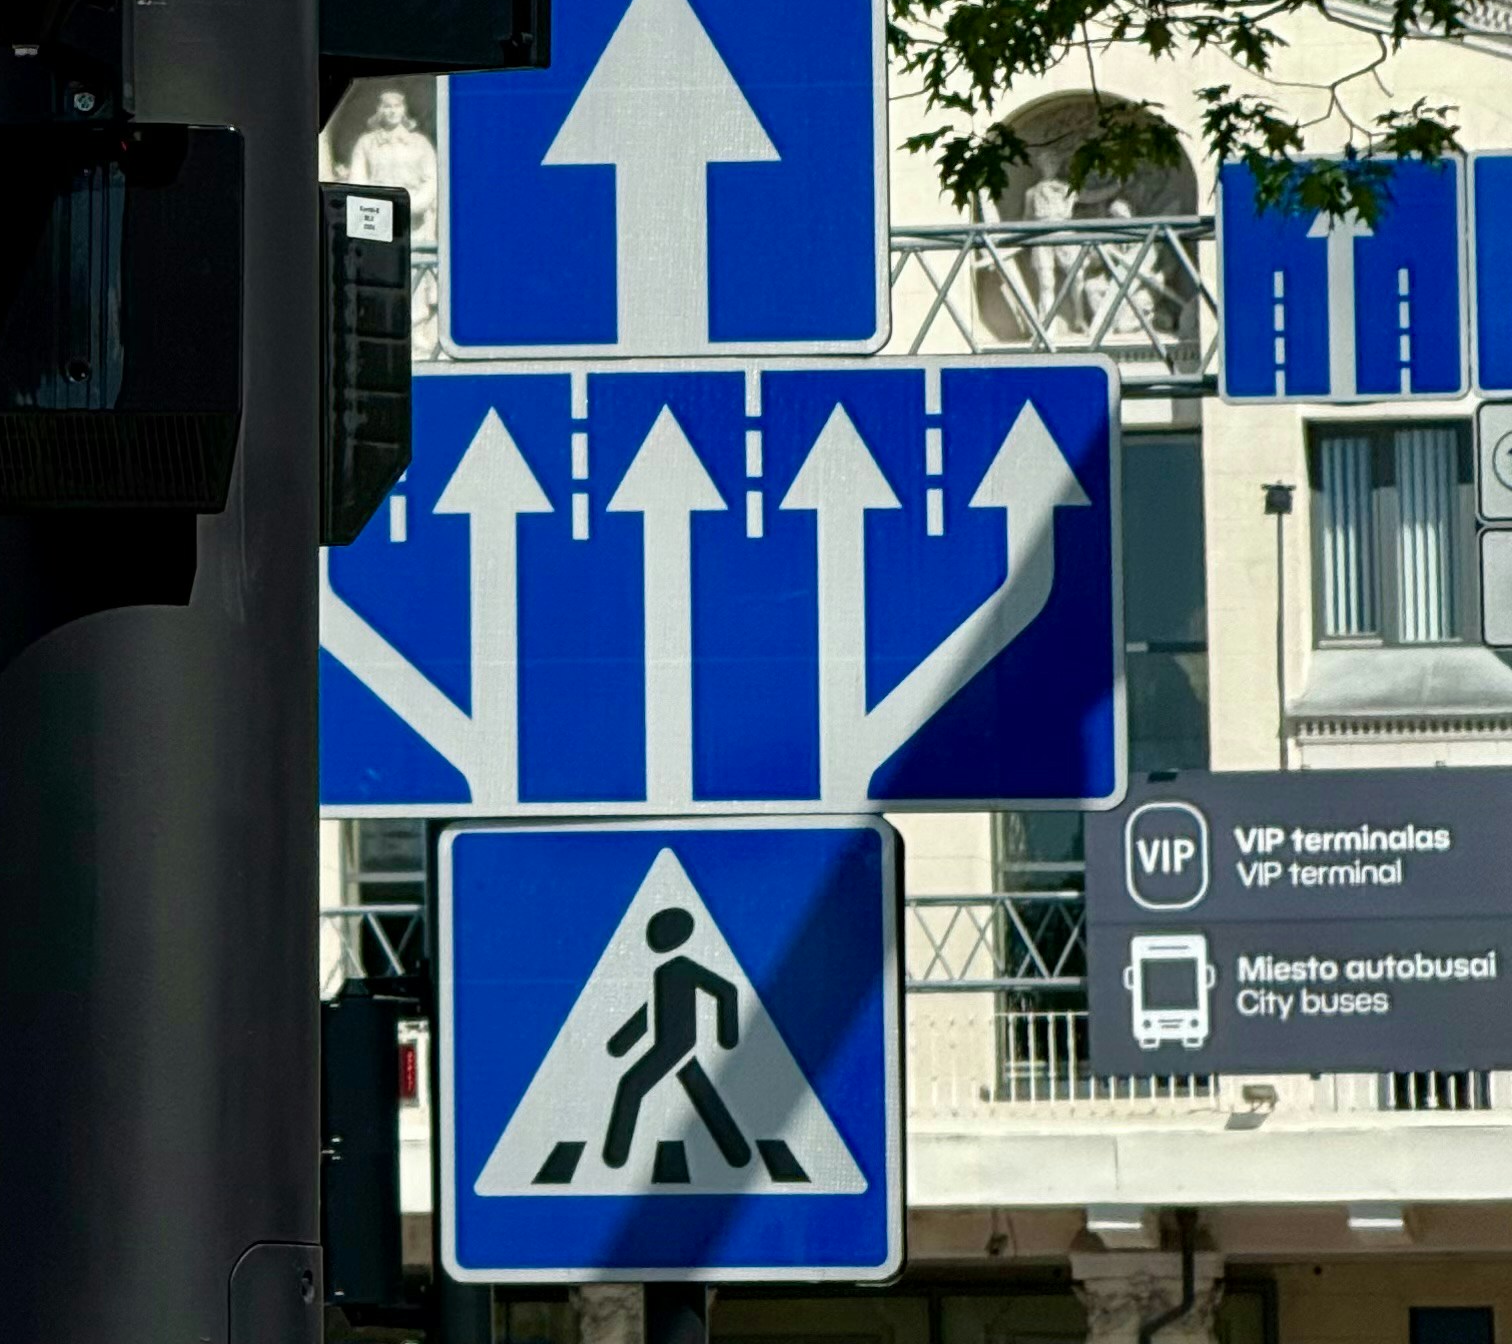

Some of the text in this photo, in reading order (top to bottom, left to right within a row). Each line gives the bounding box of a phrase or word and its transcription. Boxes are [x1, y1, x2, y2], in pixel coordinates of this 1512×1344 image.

[1234, 823, 1451, 854] VIP terminalas
[1136, 838, 1196, 874] VIP
[1236, 857, 1403, 888] VIP terminal
[1238, 950, 1497, 983] Miesto autobusai
[1237, 987, 1390, 1022] City buses
